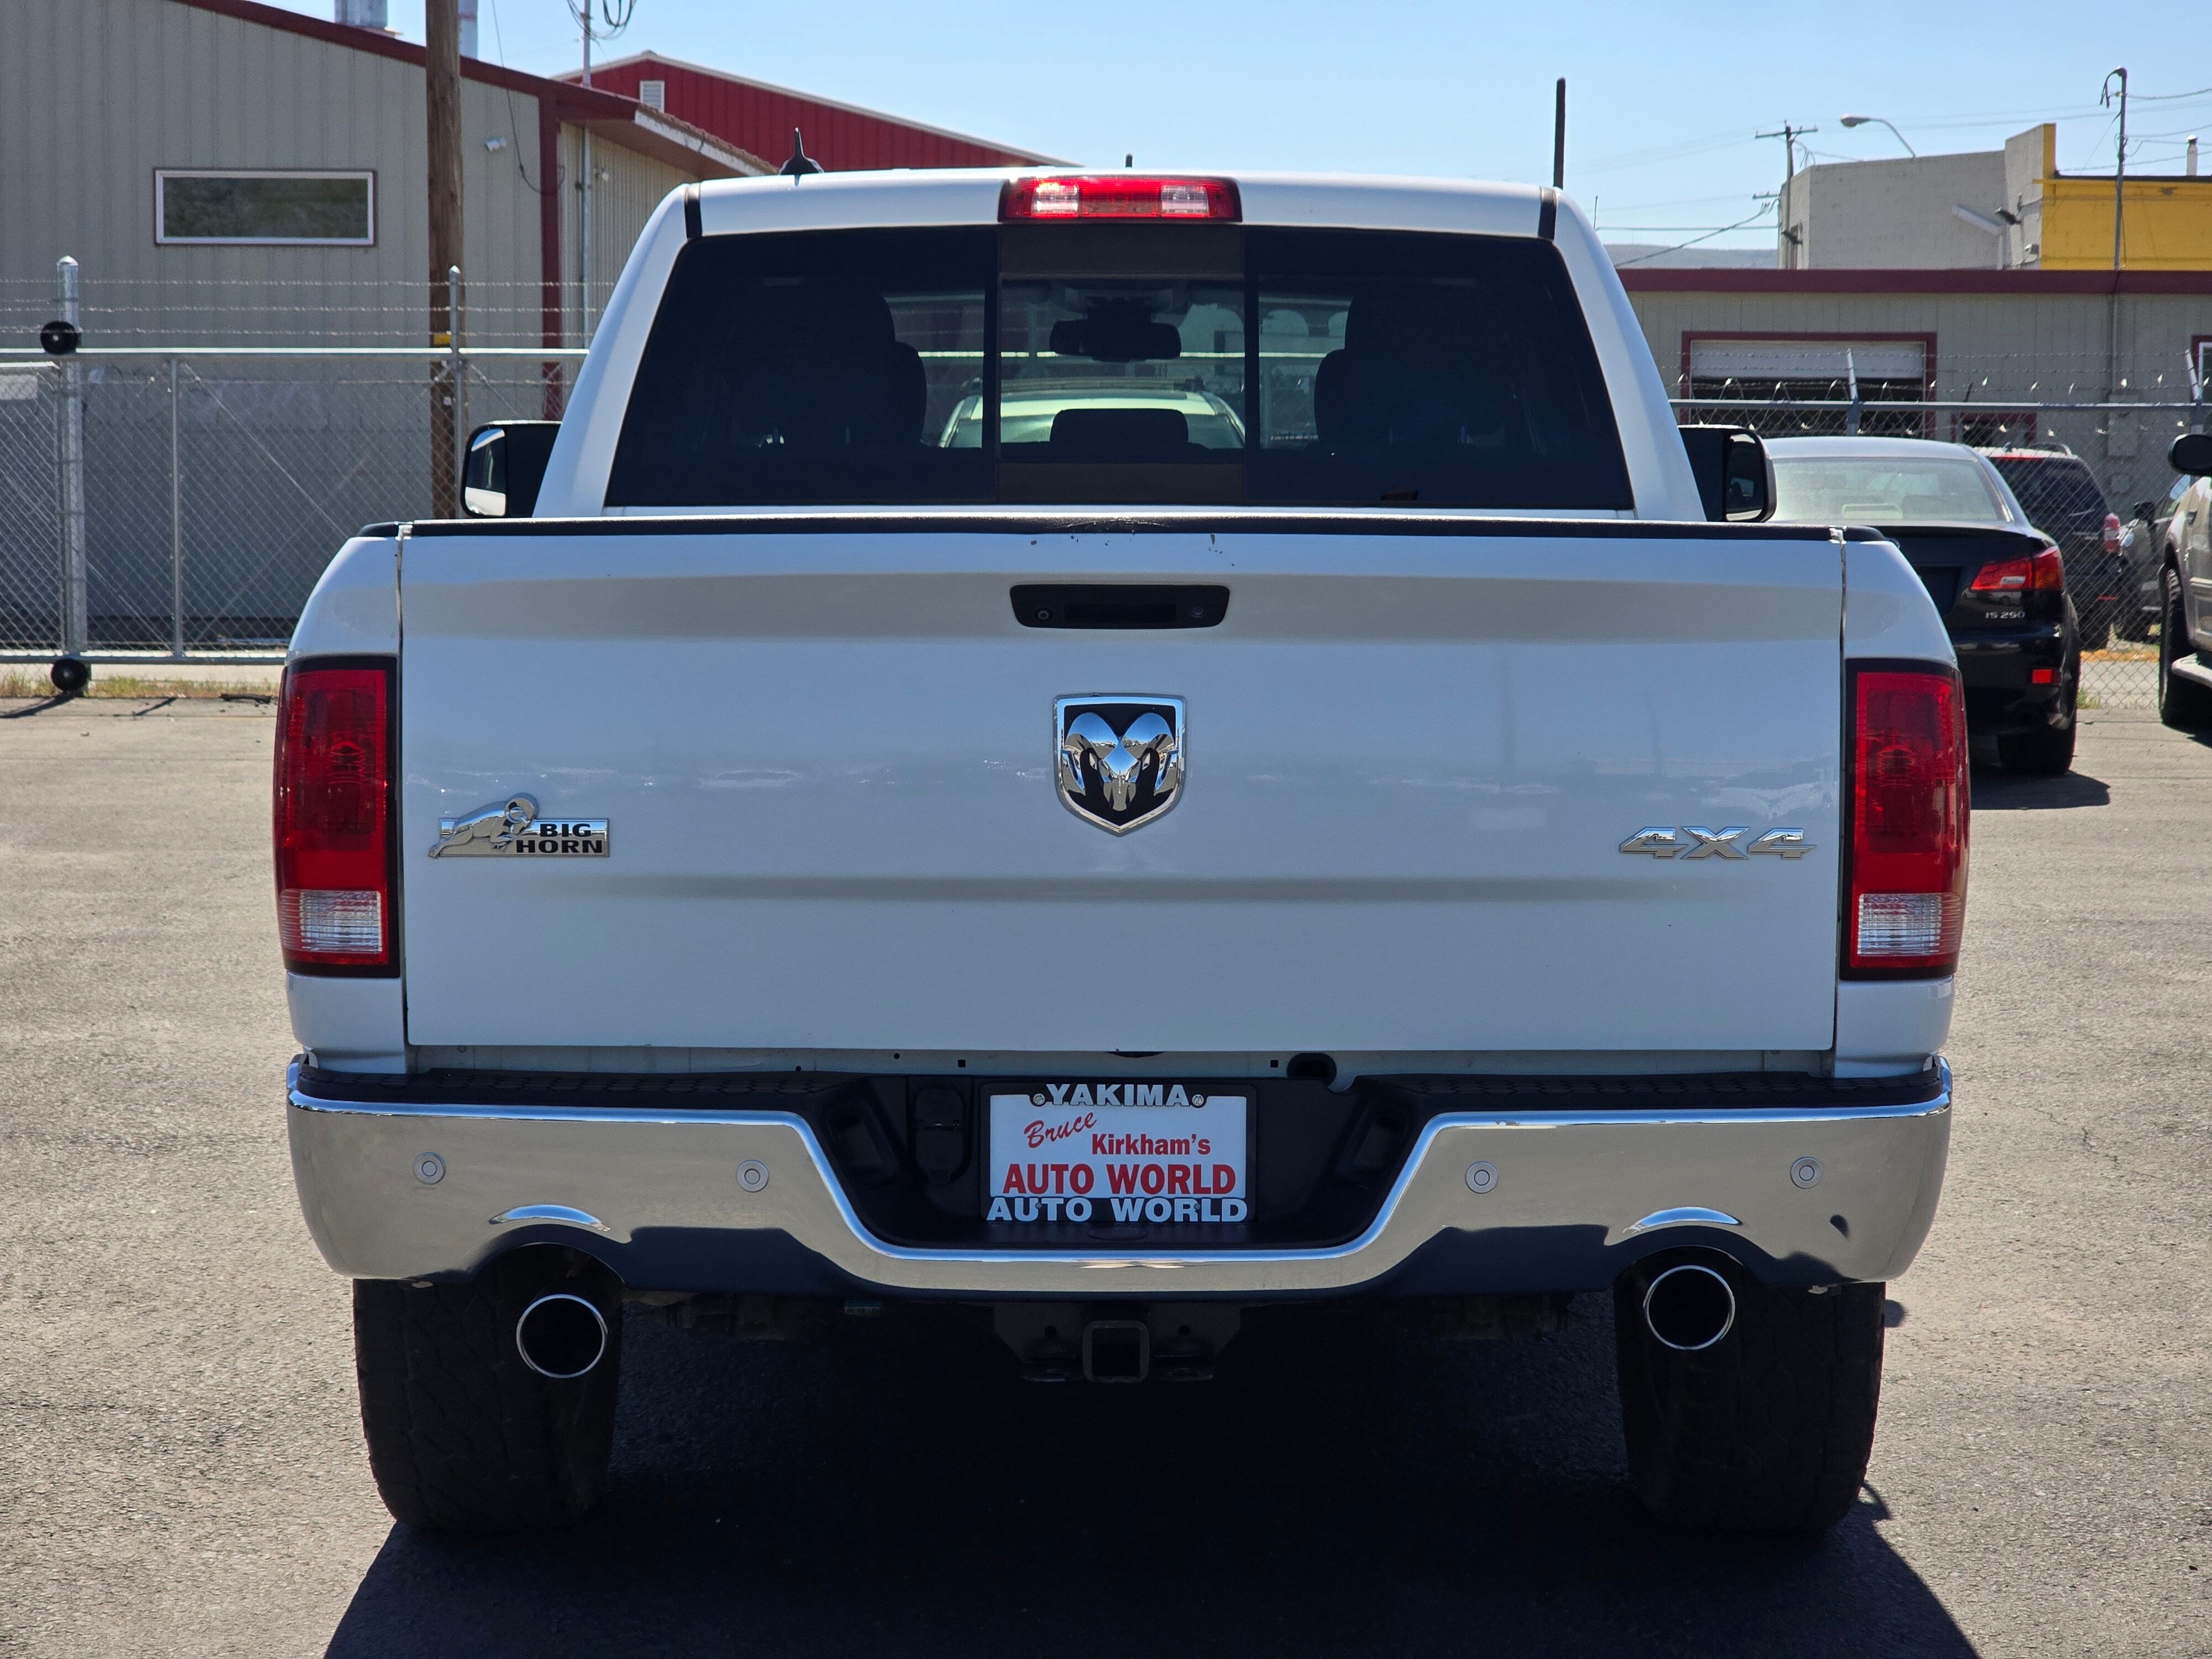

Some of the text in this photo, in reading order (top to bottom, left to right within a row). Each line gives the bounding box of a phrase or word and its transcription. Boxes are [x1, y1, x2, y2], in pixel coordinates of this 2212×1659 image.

[2000, 611, 2025, 619] 250
[540, 823, 591, 837] BIG
[516, 839, 602, 853] HORN
[1046, 1084, 1190, 1106] YAKIMA
[1024, 1112, 1097, 1149] Bruce
[1092, 1134, 1211, 1155] Kirkham's
[1003, 1164, 1236, 1194] AUTO WORLD
[987, 1197, 1247, 1222] AUTO WORLD
